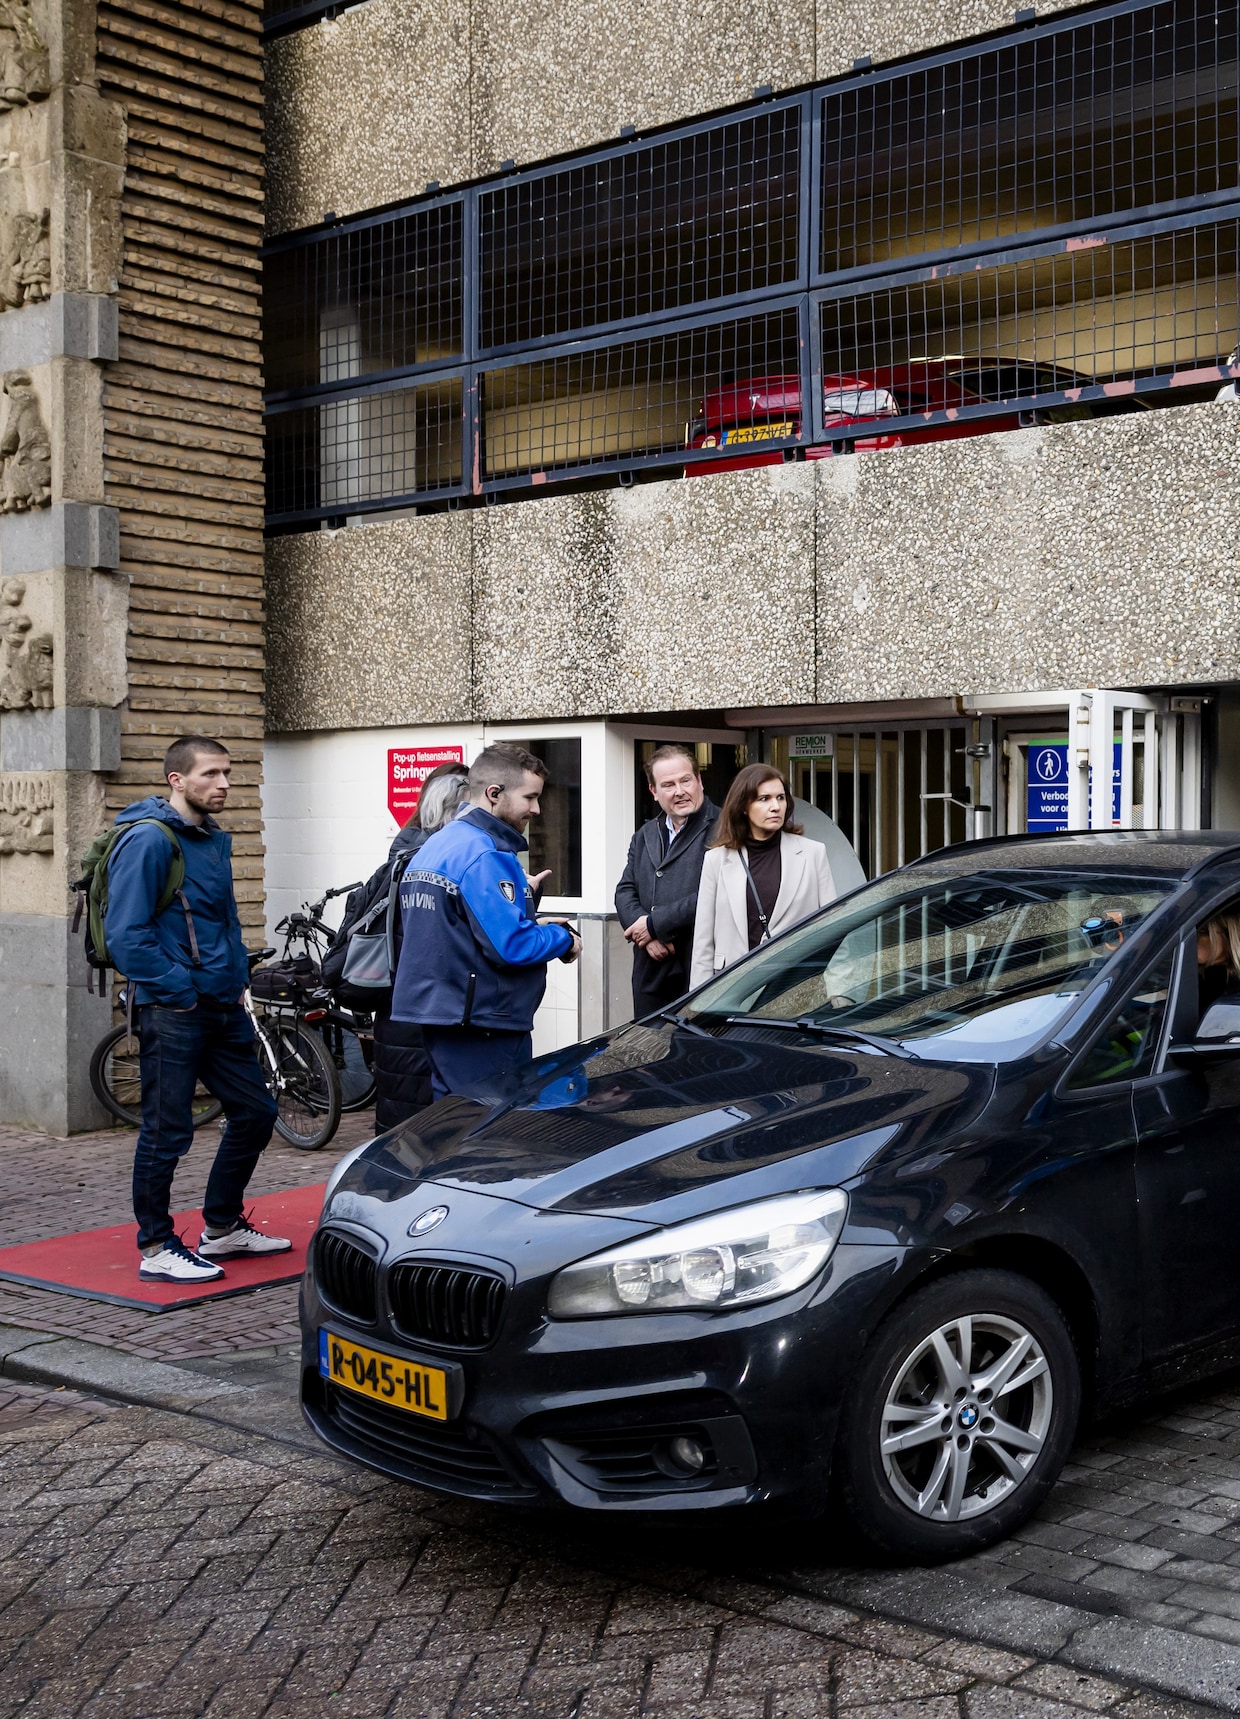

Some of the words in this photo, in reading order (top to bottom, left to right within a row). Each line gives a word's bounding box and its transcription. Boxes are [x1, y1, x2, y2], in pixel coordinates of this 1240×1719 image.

[393, 753, 416, 764] Pop-up
[417, 751, 461, 762] fietsenstalling
[1041, 804, 1059, 812] voor
[332, 1342, 439, 1412] R-045-HL
